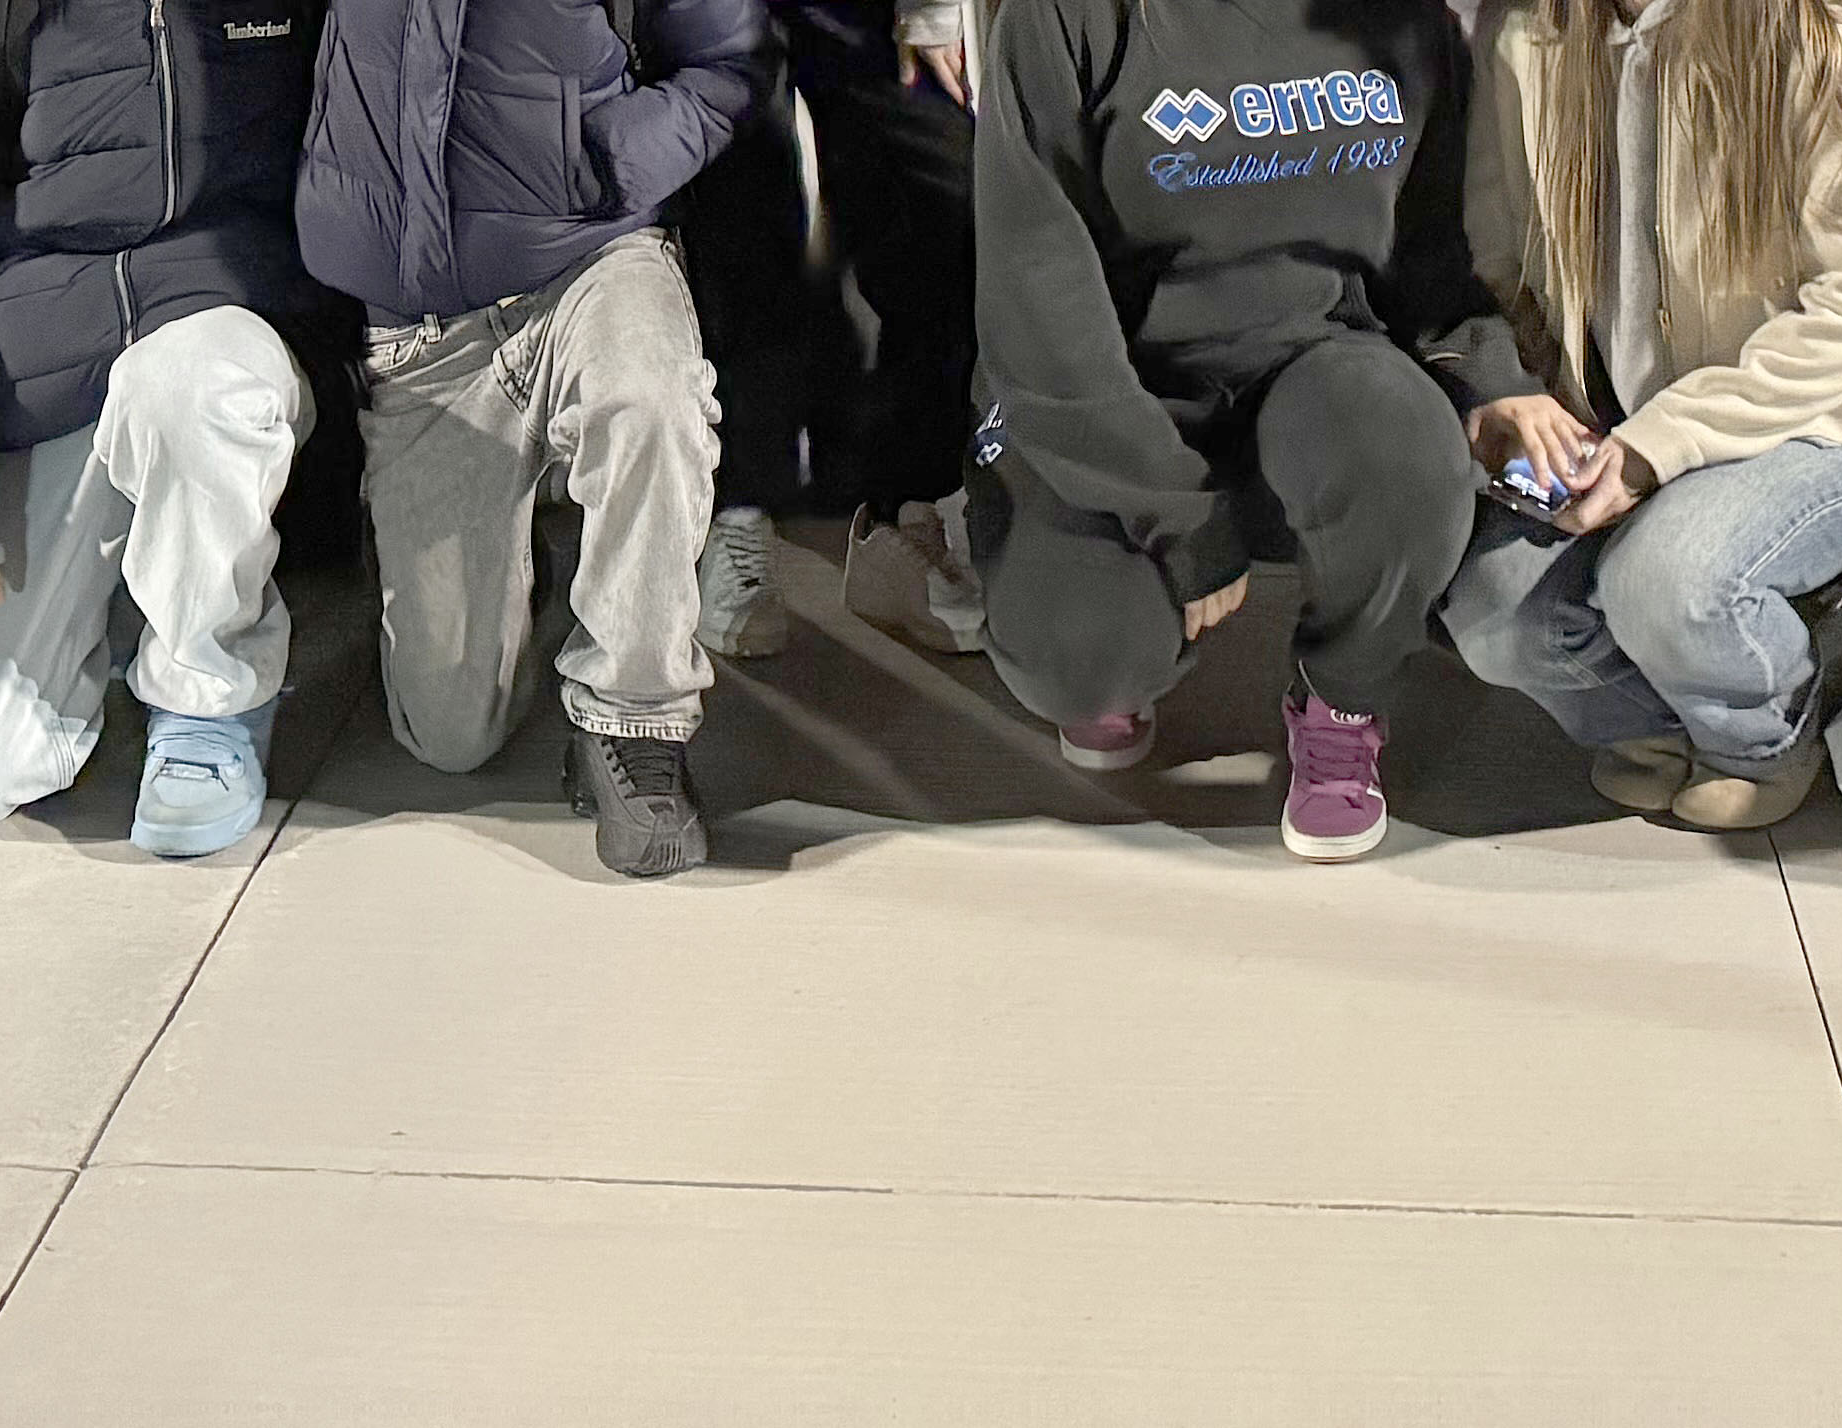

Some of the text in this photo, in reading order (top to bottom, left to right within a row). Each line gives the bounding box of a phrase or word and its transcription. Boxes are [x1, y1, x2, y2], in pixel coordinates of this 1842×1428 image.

[223, 18, 291, 39] Timberland
[1229, 69, 1404, 137] errea
[1149, 136, 1405, 193] Established 1988
